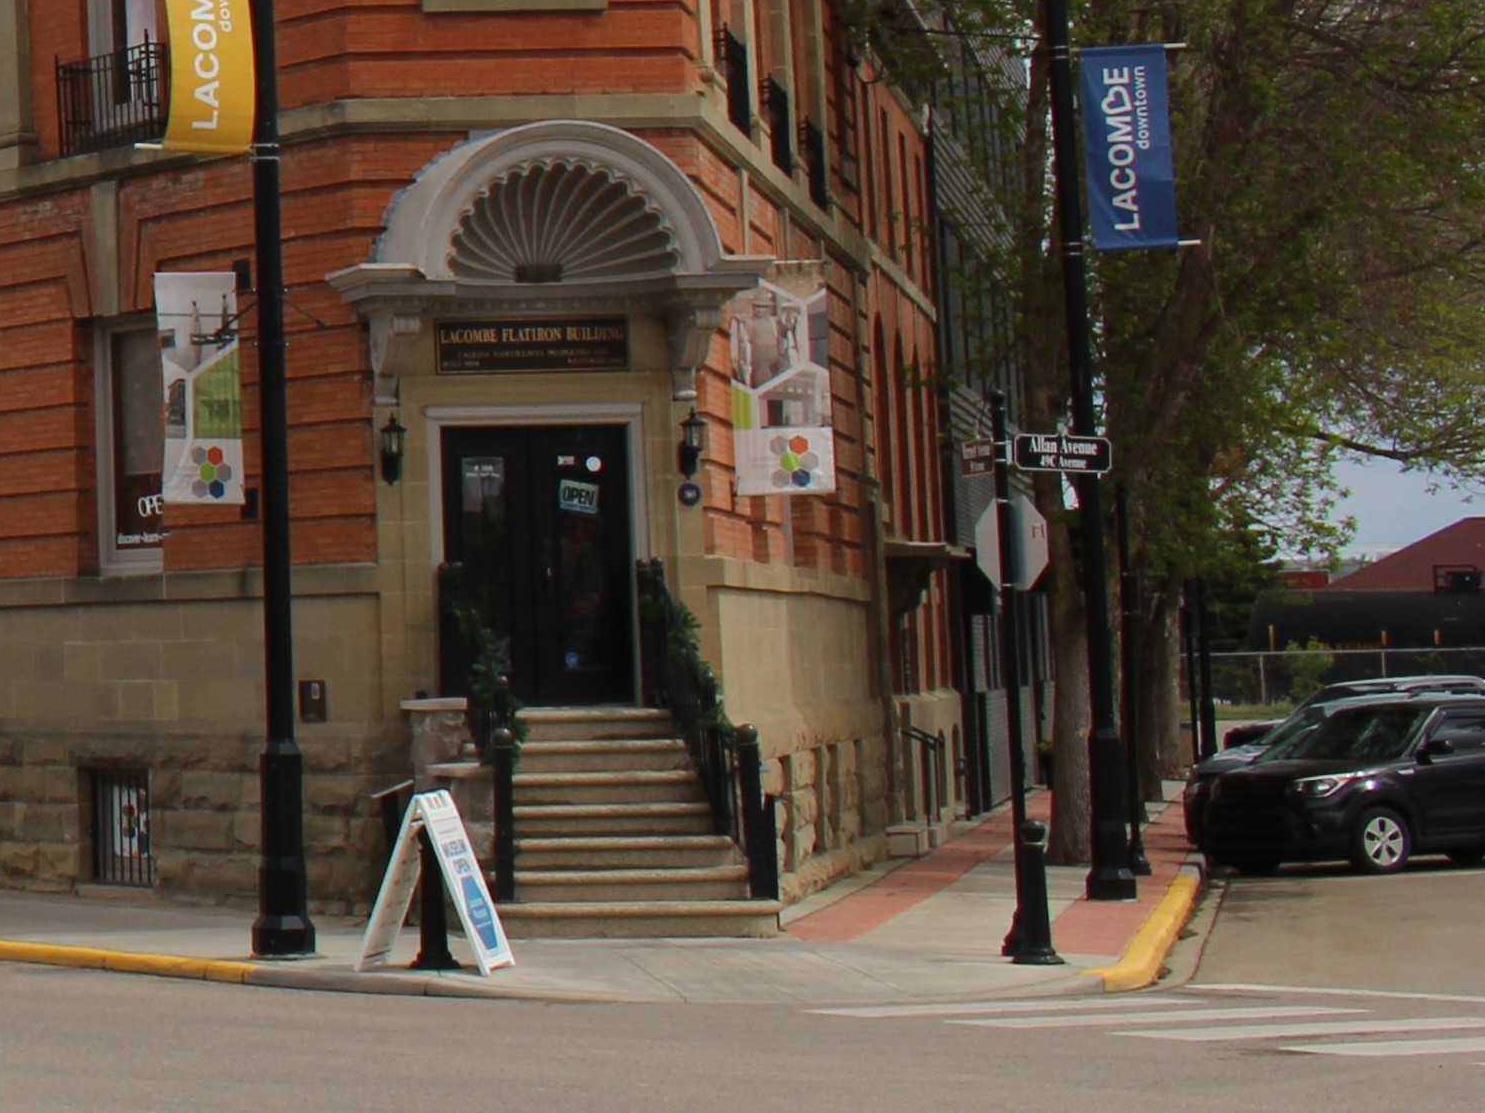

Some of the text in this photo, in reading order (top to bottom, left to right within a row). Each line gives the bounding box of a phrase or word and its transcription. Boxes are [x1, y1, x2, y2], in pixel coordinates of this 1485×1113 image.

[1133, 65, 1150, 150] downtown
[440, 326, 624, 345] LACOMBE FLATIRON BUILDING
[1029, 437, 1098, 456] Allan Avenue
[1058, 456, 1087, 469] Avenue
[138, 494, 164, 517] OPE
[564, 486, 595, 506] OPEN
[453, 858, 471, 876] OPEN
